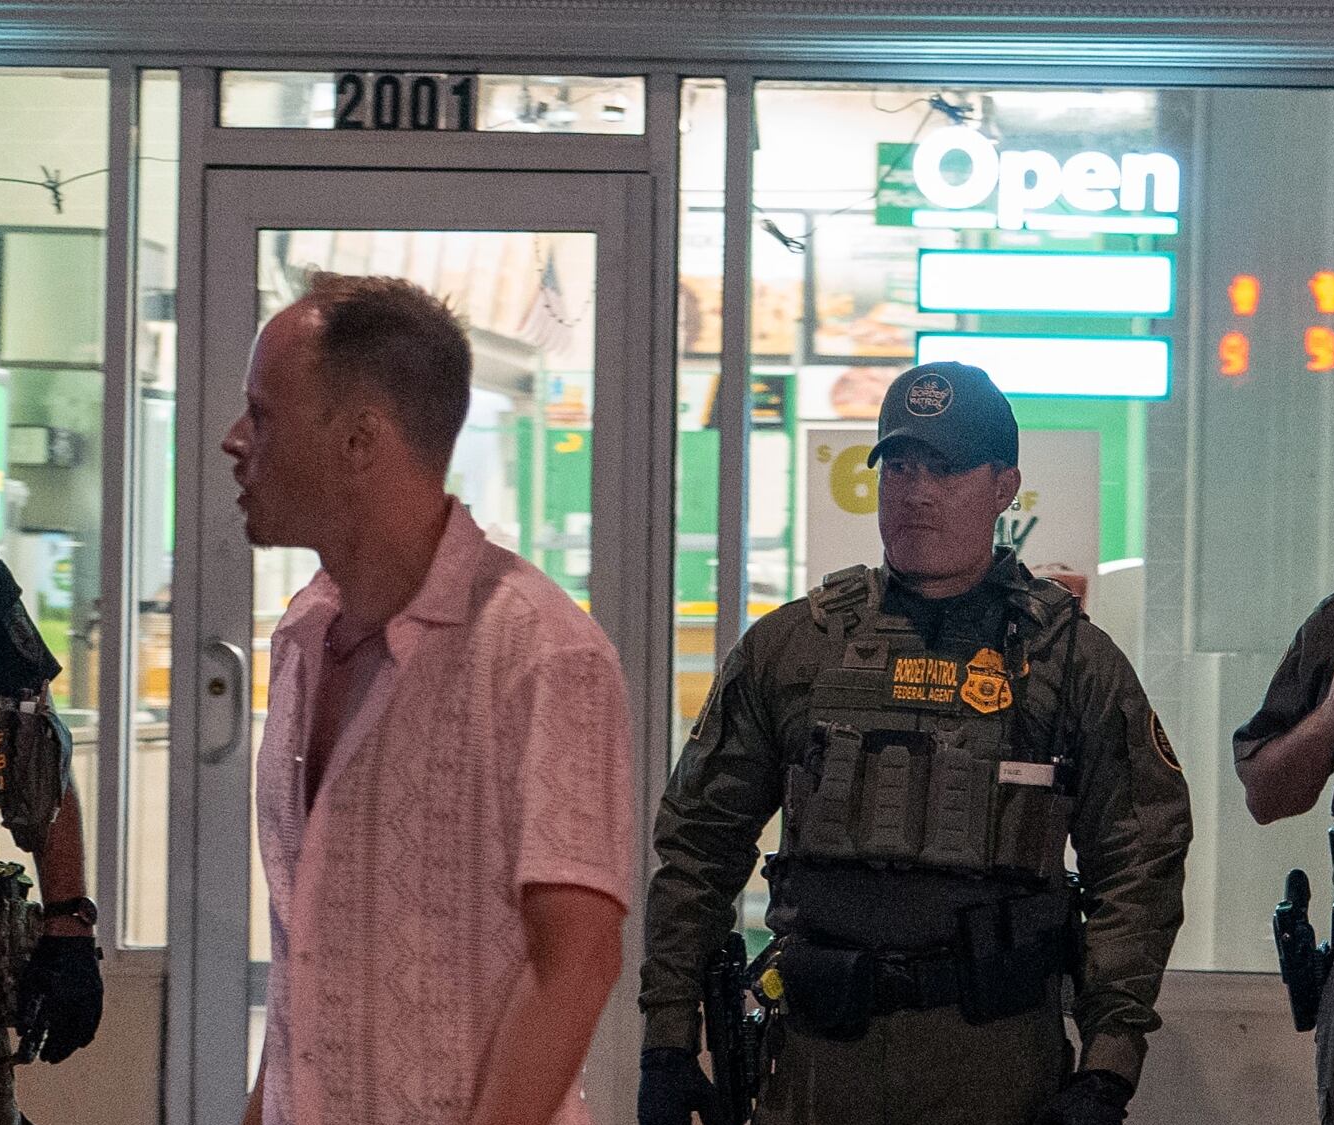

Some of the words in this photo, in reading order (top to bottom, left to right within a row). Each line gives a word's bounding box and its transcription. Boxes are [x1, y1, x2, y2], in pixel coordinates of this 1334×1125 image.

[336, 73, 472, 130] 2001
[913, 125, 1181, 230] Open
[910, 397, 944, 410] PATROL
[893, 658, 926, 684] BORDER
[927, 659, 958, 686] PATROL
[892, 685, 926, 701] FEDERAL
[928, 687, 956, 703] AGENT
